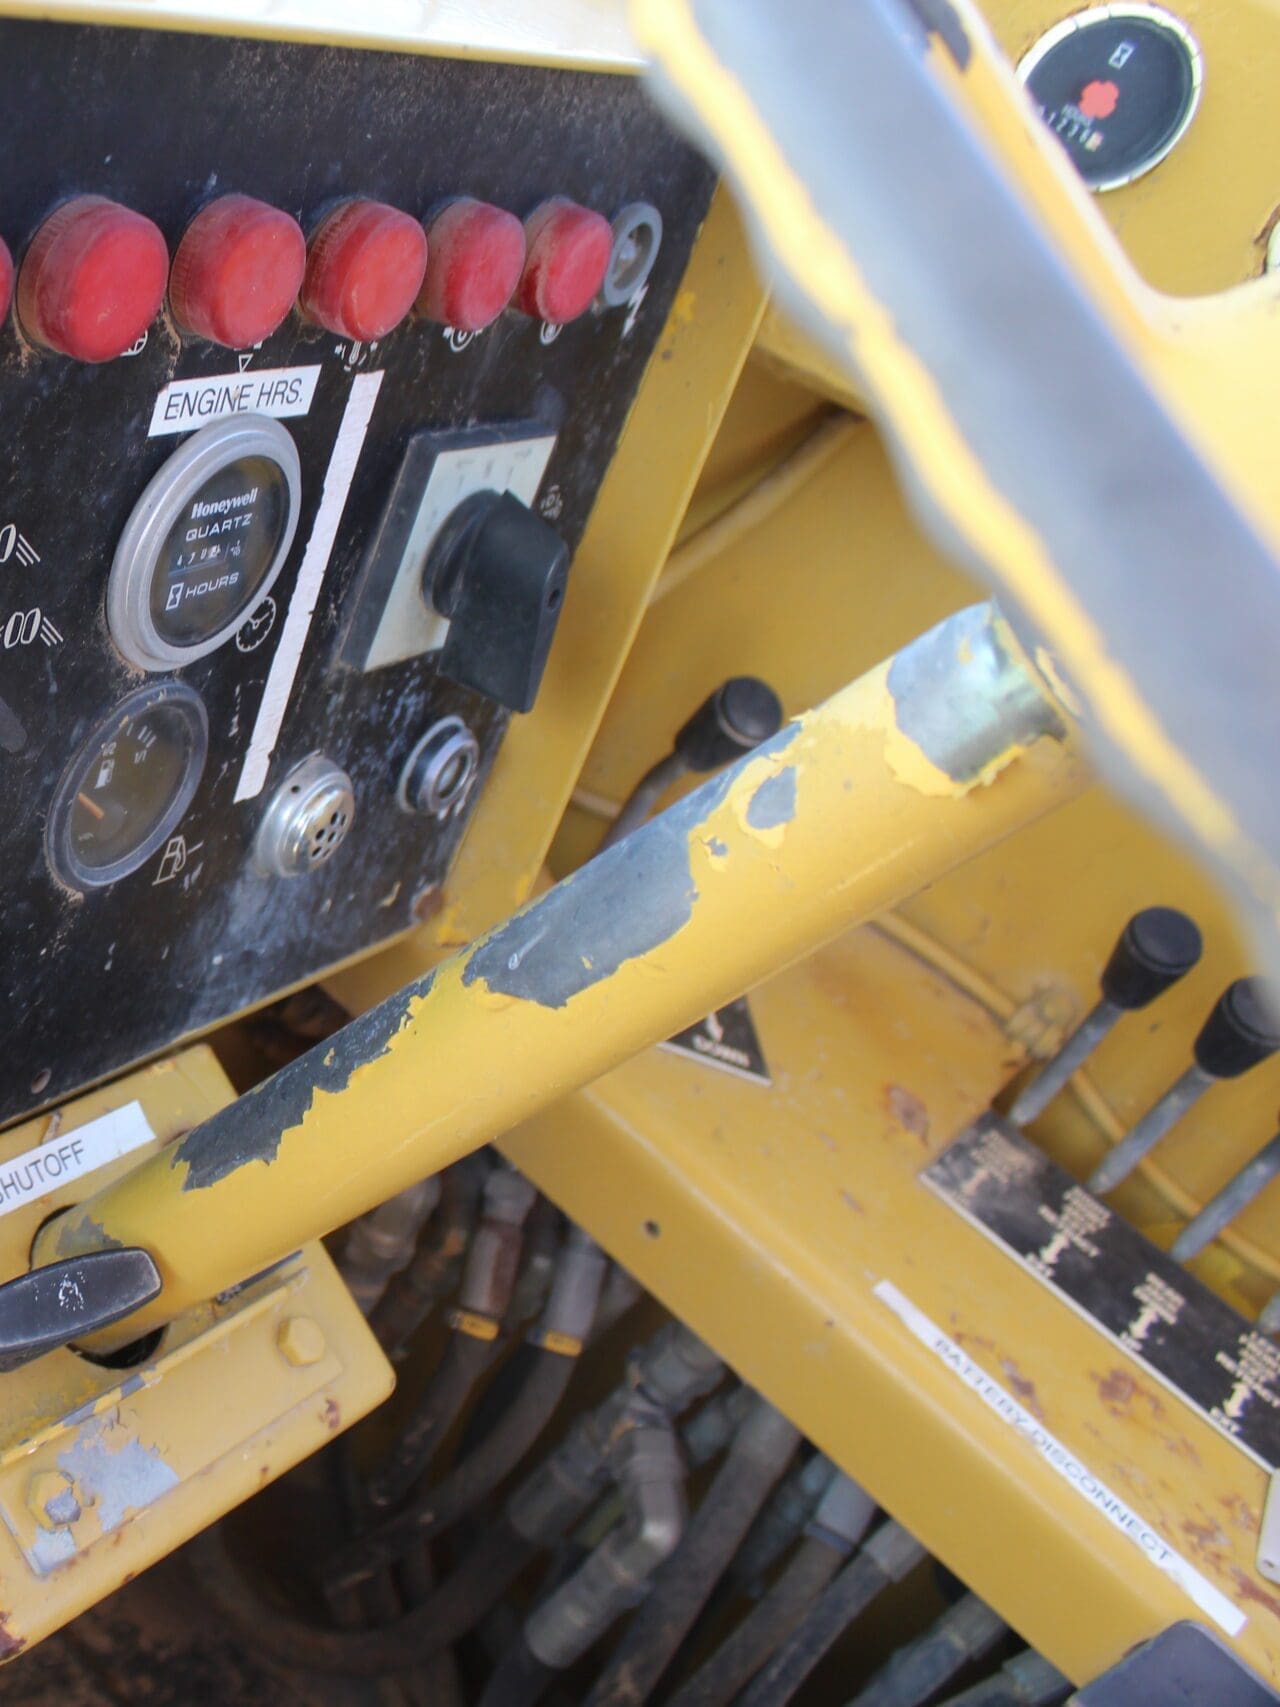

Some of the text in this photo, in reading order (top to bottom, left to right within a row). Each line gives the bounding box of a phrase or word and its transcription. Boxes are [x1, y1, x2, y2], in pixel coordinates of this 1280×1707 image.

[164, 378, 304, 421] ENGINE HRS.
[191, 487, 259, 519] Honeywell
[185, 513, 253, 542] QUARTZ
[185, 572, 240, 599] HOURS
[934, 1339, 1171, 1561] BATTERY DISCONNECT
